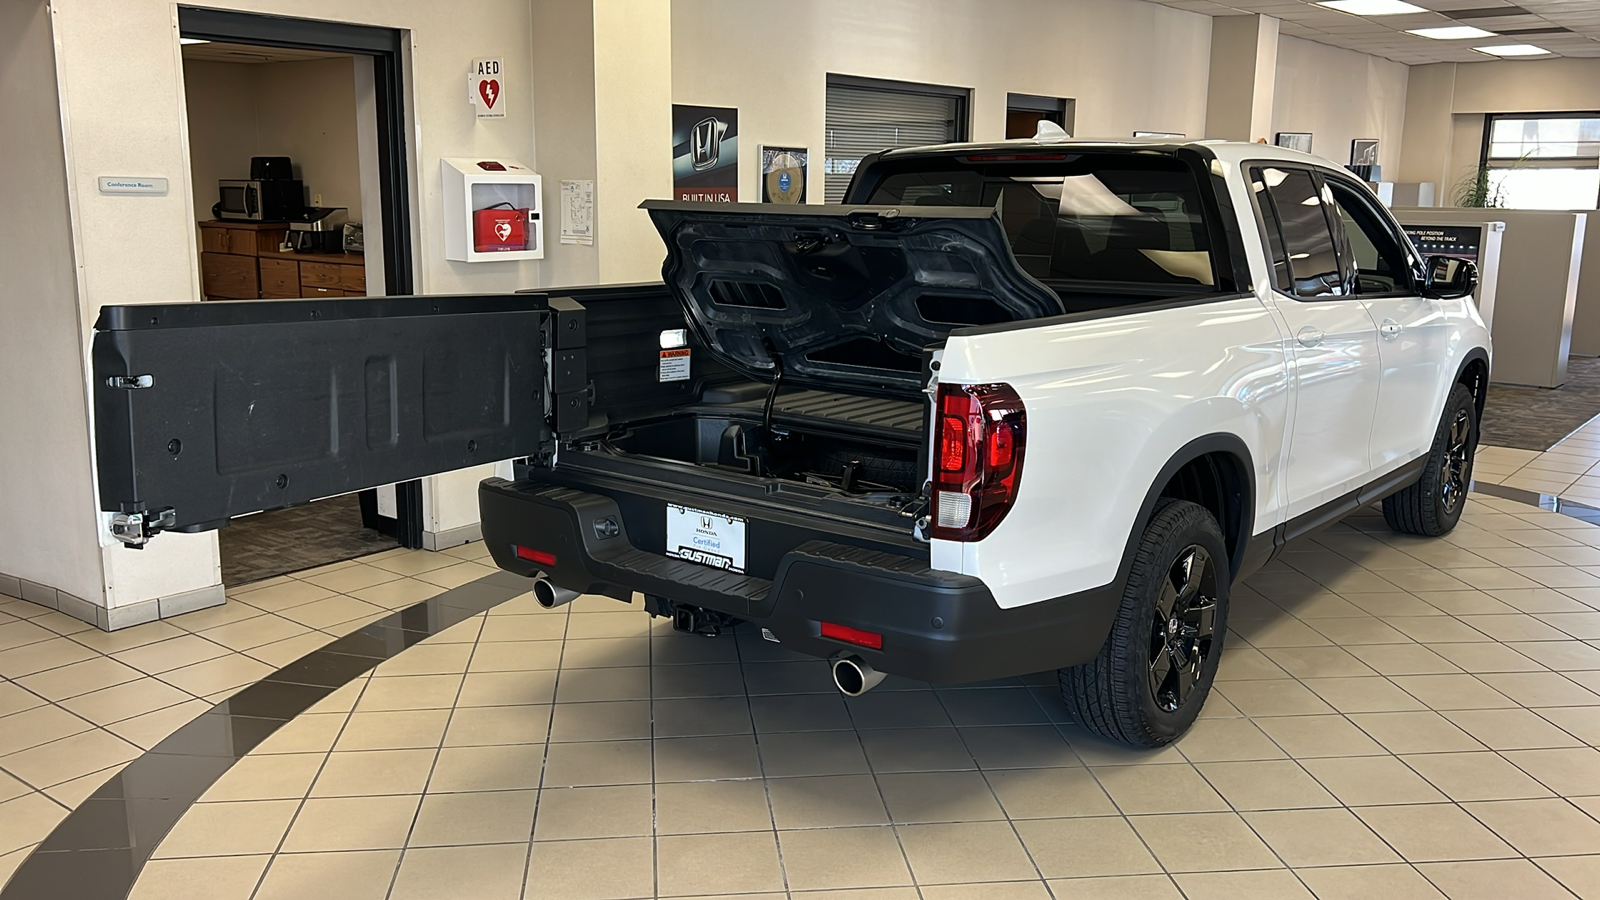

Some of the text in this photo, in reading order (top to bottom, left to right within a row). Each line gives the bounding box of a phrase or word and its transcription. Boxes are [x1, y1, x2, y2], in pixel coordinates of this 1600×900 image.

[478, 61, 499, 75] AED
[682, 193, 731, 203] BUILT IN USA
[695, 528, 718, 537] HONDA
[693, 536, 721, 549] Certified
